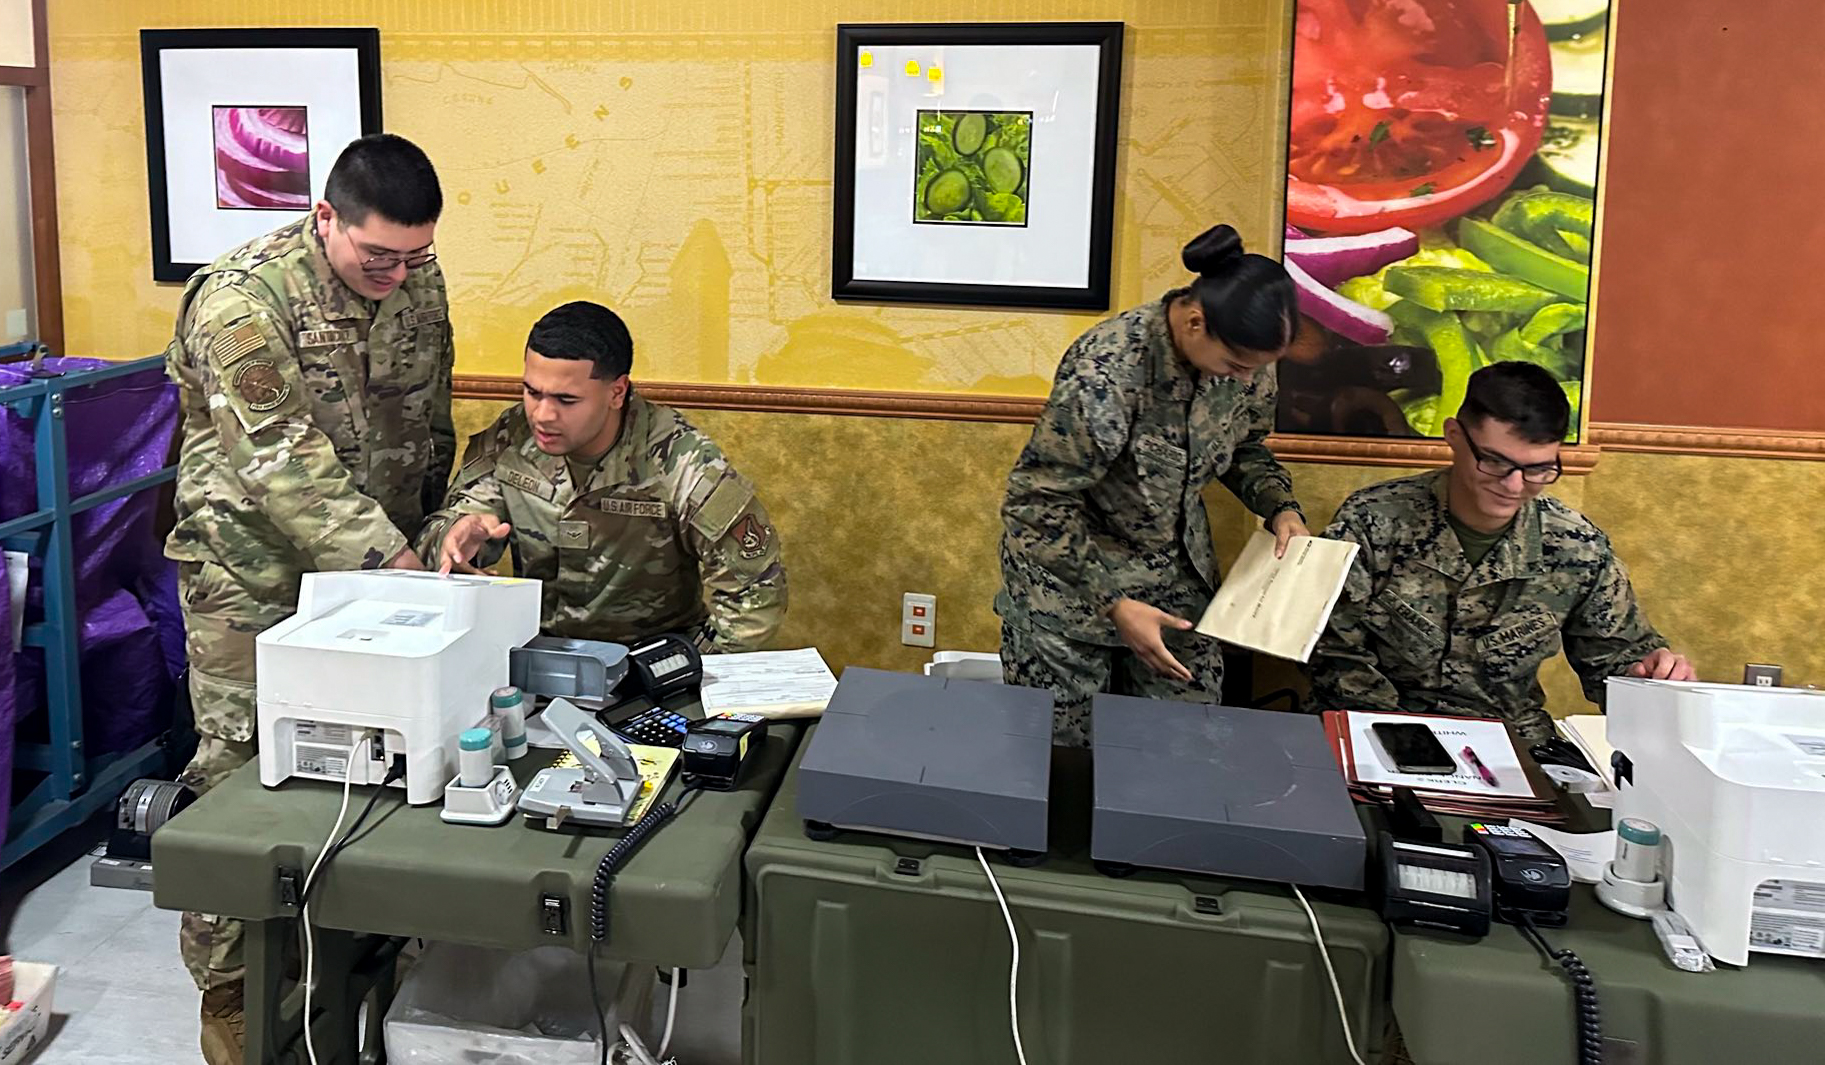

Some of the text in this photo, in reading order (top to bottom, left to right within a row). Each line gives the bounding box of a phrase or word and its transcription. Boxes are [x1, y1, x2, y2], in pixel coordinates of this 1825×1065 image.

[508, 471, 541, 492] DELEON
[619, 502, 633, 514] AIR
[633, 503, 663, 516] FORCE
[1499, 617, 1546, 644] MARINES
